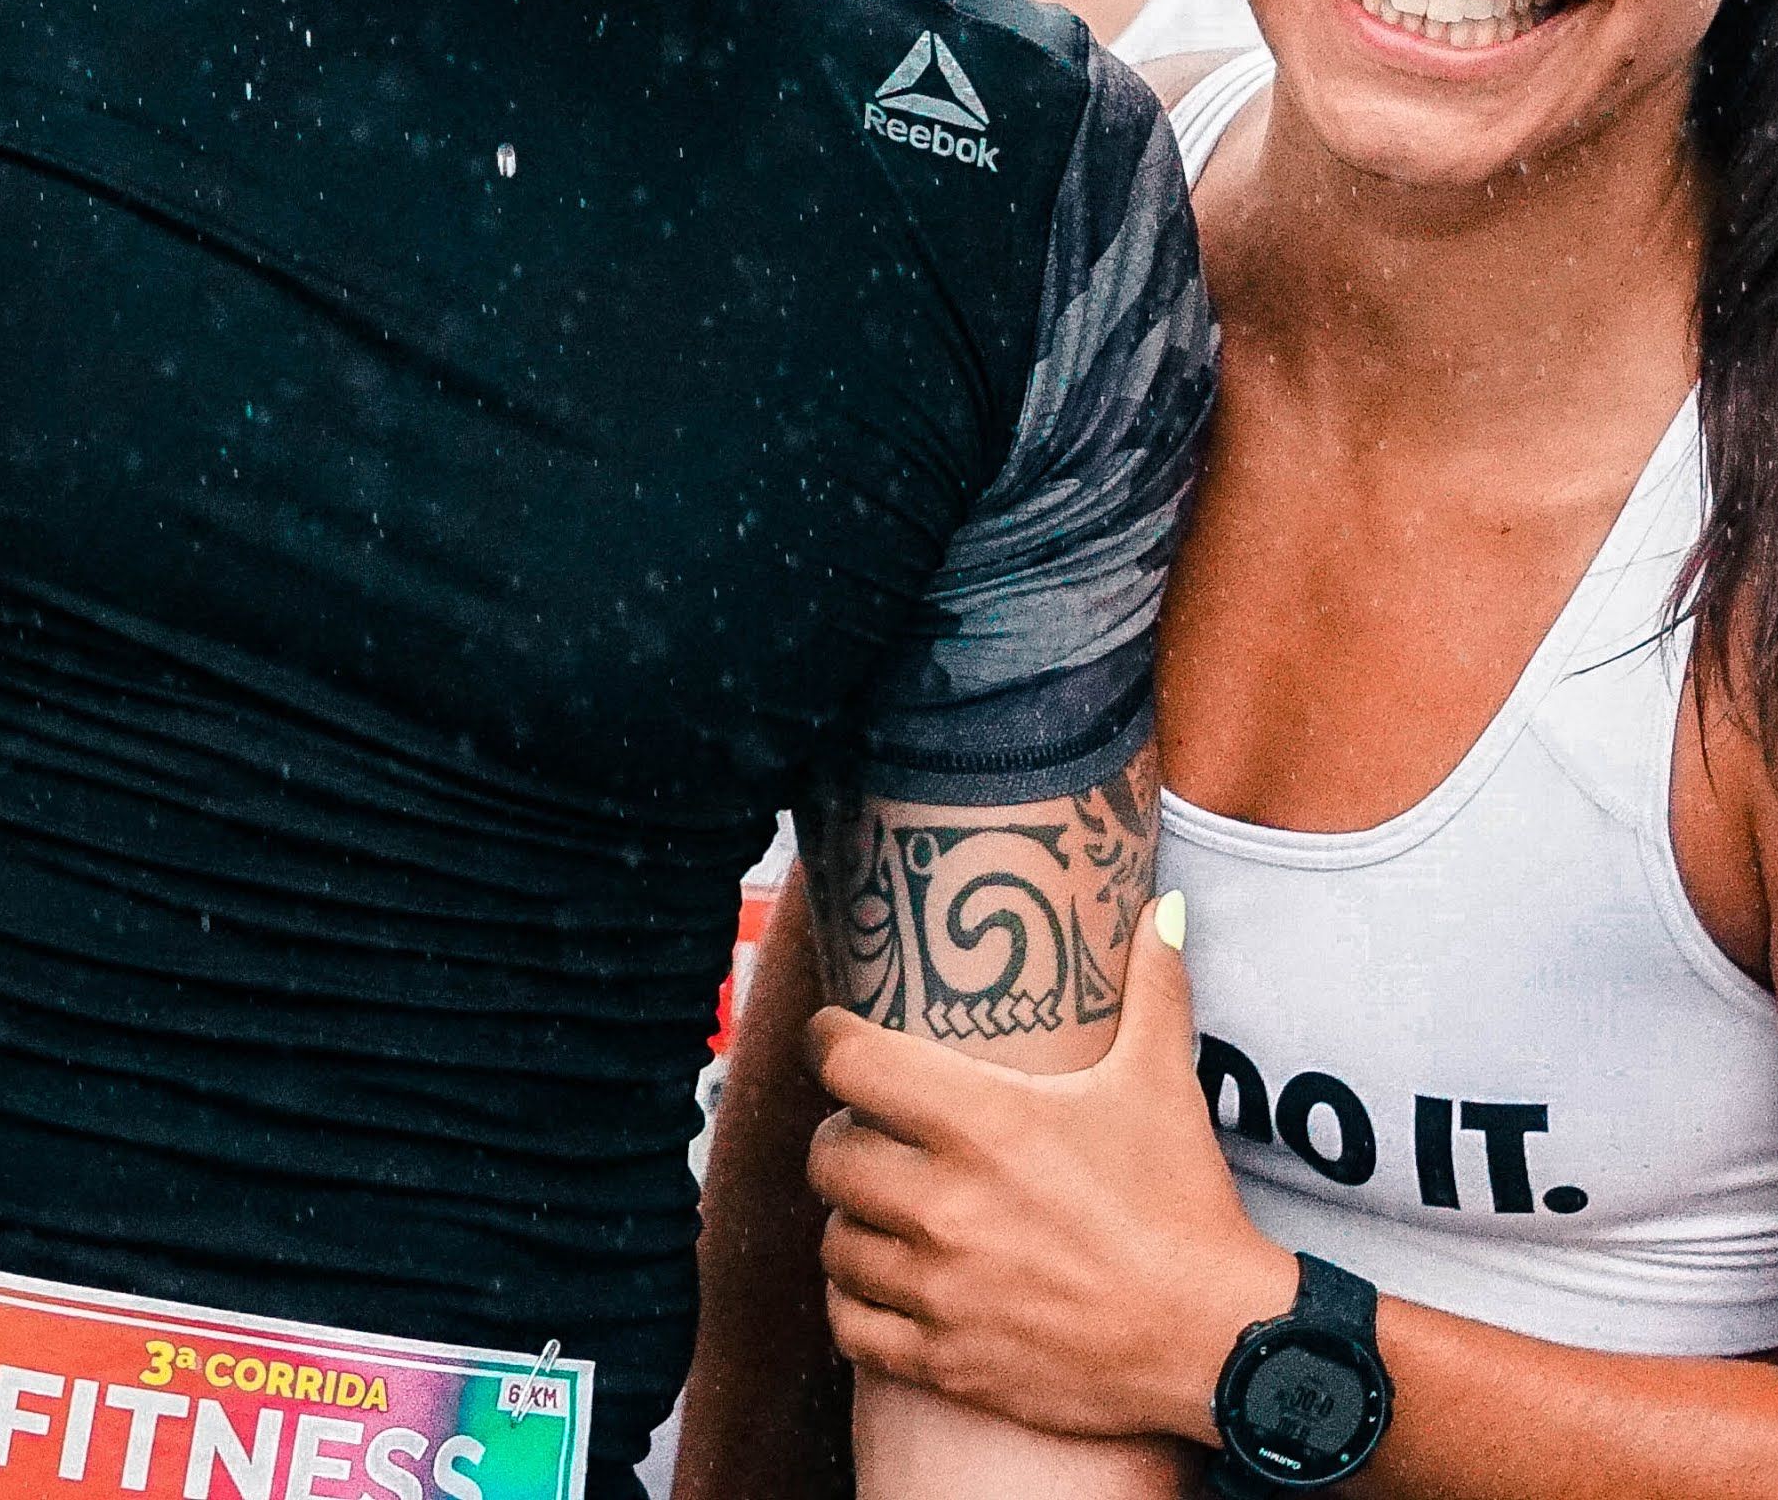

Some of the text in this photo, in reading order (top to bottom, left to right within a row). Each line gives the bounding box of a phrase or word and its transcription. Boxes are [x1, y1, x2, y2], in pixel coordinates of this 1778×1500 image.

[863, 102, 1000, 173] Reebok
[1414, 1094, 1589, 1215] IT.
[204, 1353, 389, 1412] CORRIDA
[508, 1384, 558, 1409] 6 KM
